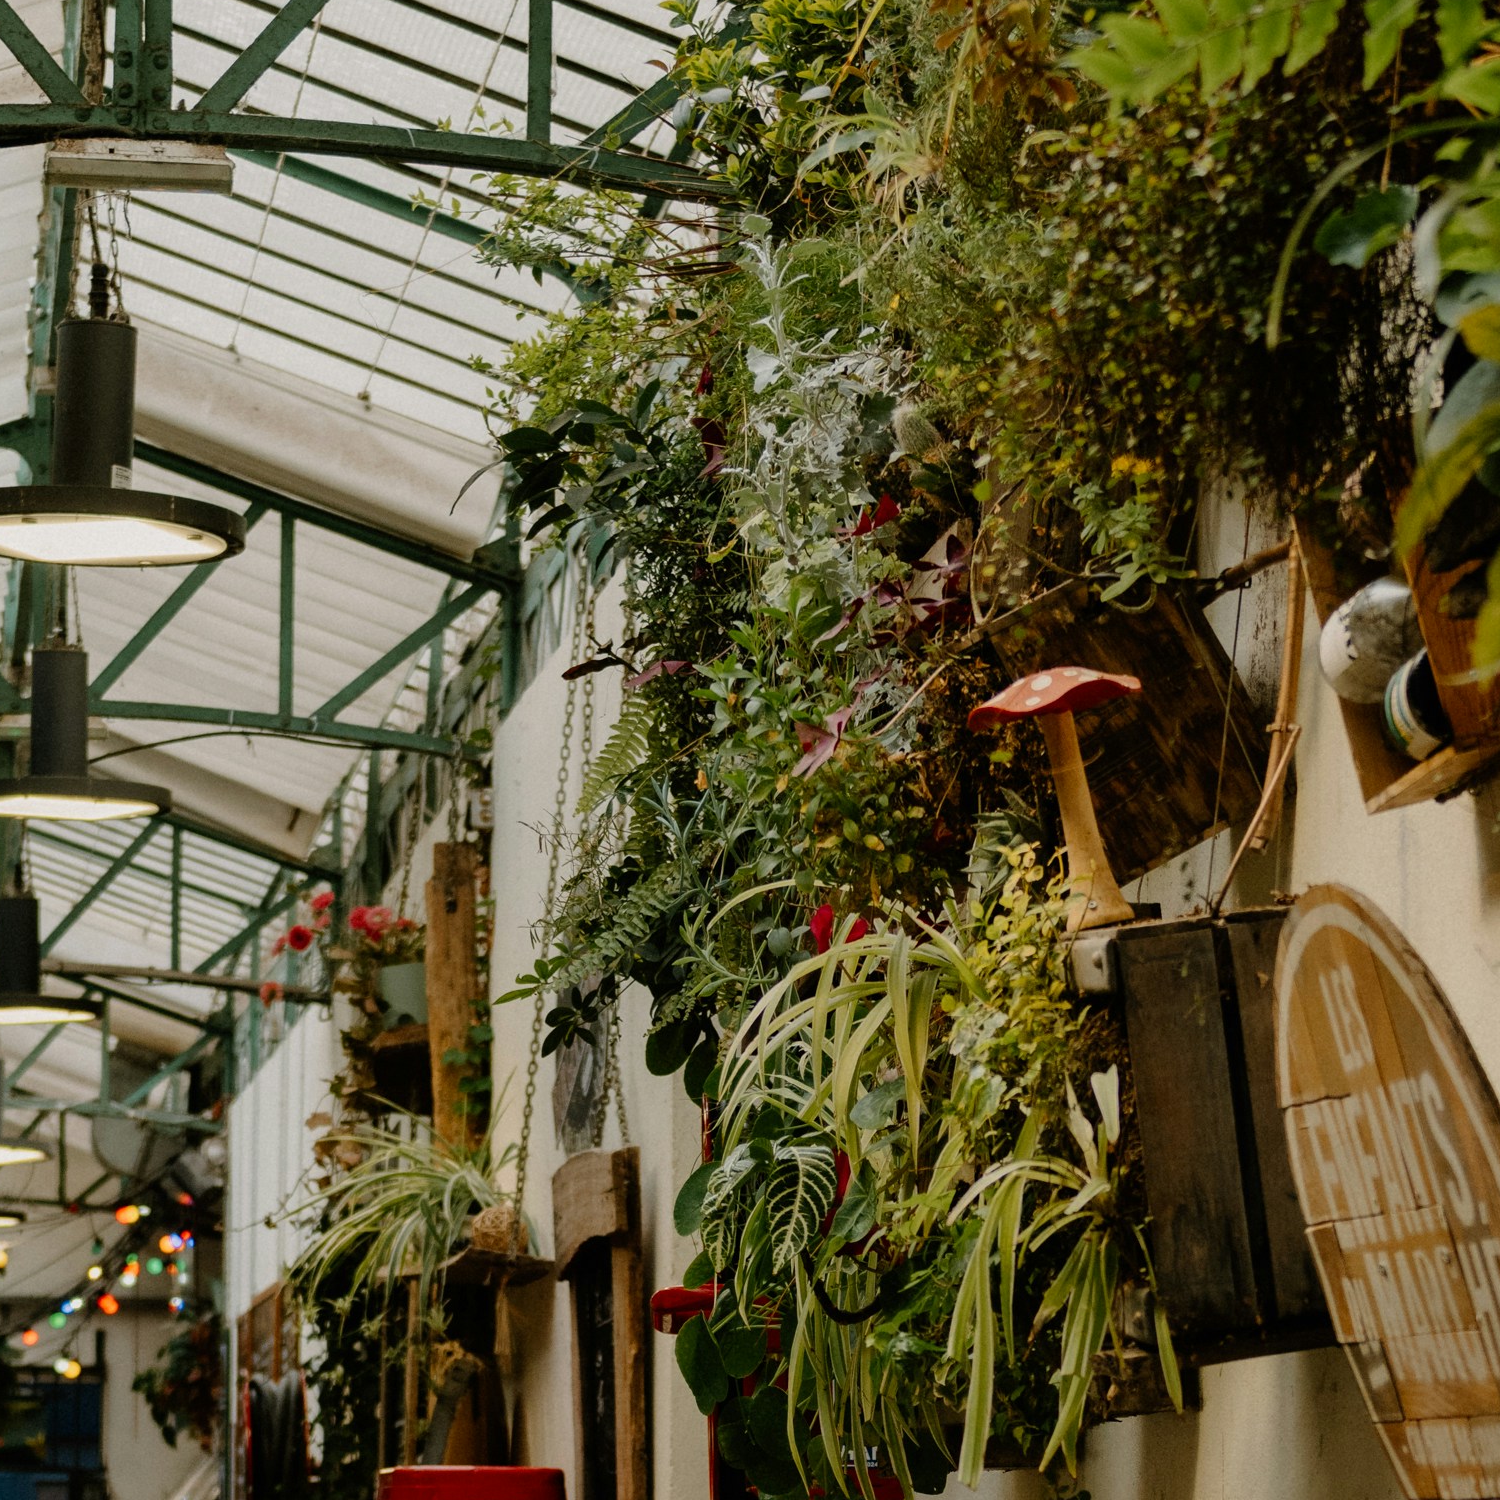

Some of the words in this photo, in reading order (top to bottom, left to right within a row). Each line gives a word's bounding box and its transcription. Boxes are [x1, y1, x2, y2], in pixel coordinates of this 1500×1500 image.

[1318, 964, 1376, 1074] LES
[1303, 1070, 1478, 1252] ENFANTS
[1341, 1277, 1391, 1391] DU
